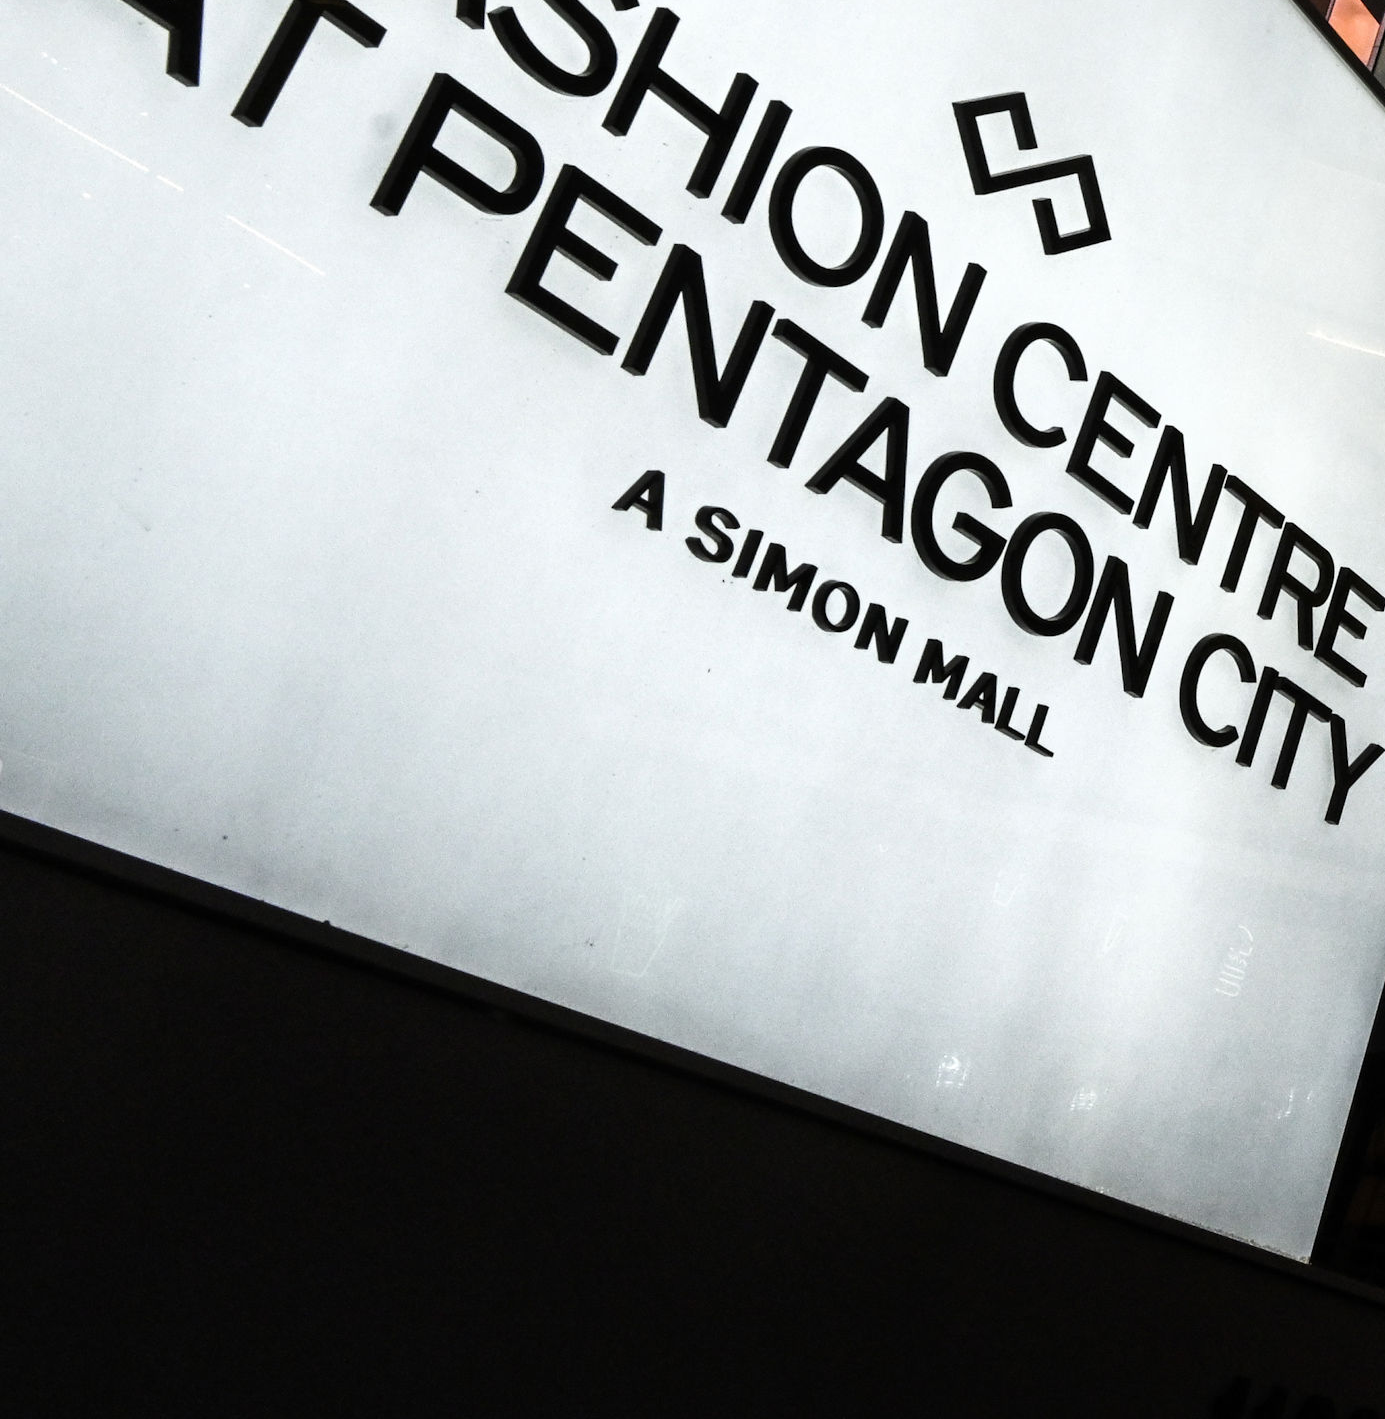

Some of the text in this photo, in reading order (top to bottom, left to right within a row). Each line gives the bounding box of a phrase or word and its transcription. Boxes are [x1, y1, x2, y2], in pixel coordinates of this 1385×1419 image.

[369, 72, 1175, 699] PENTAGON
[1179, 633, 1385, 826] CITY
[611, 470, 1054, 758] A SIMON MALL
